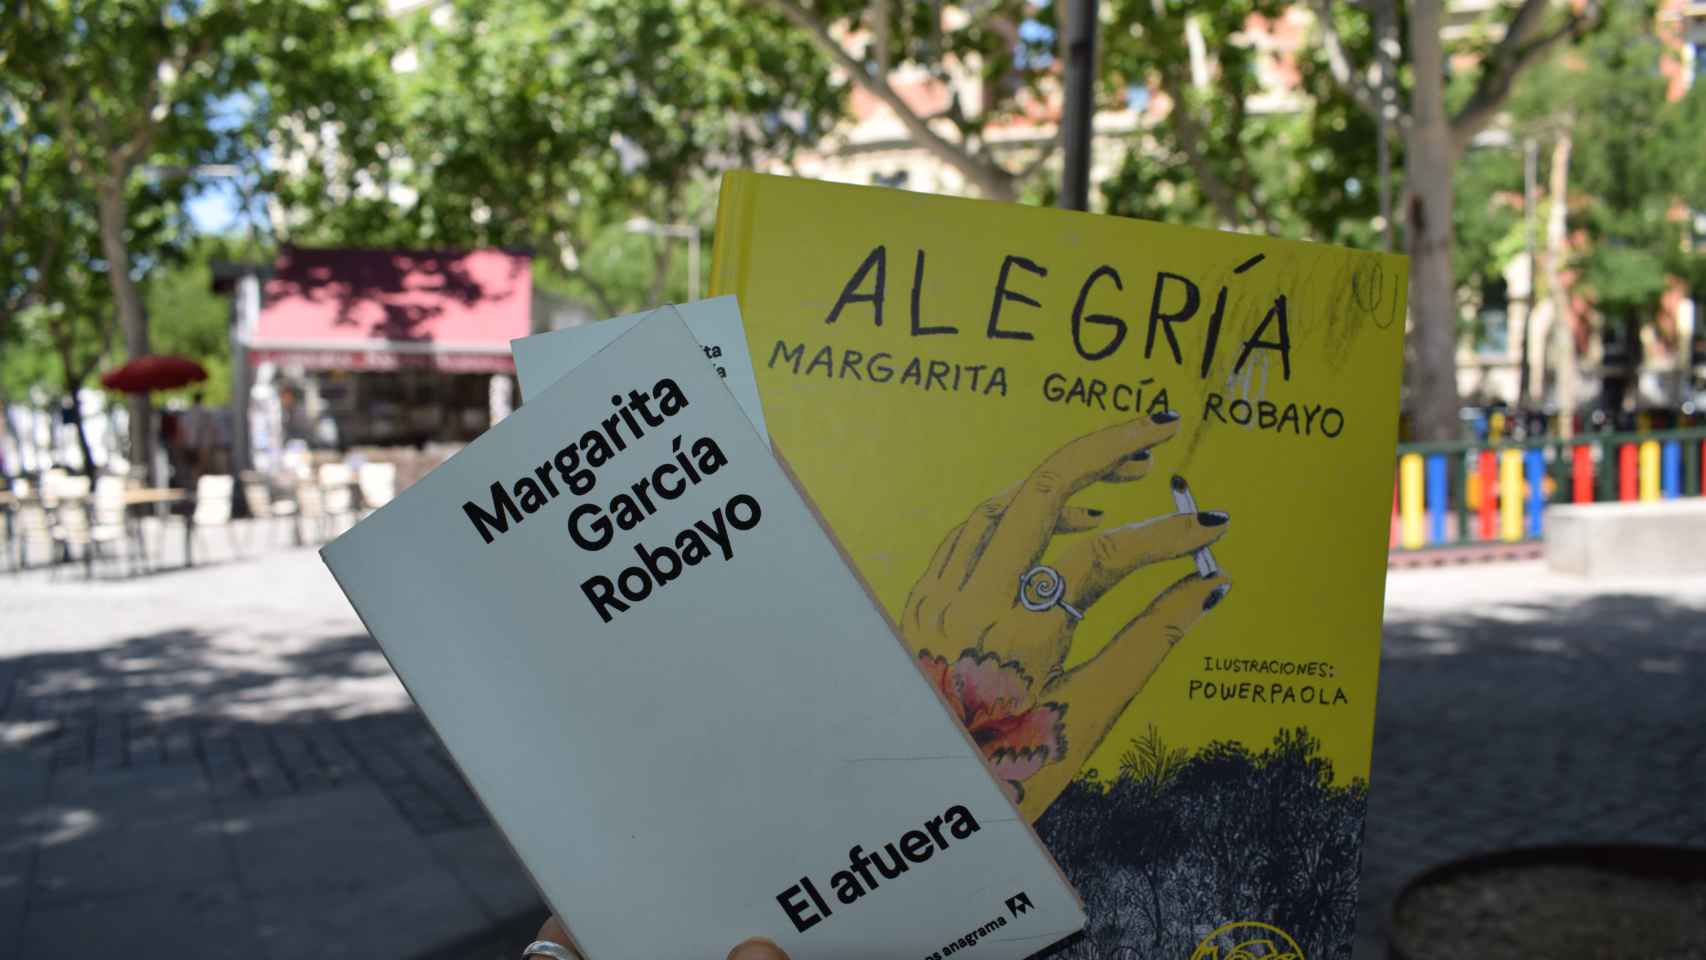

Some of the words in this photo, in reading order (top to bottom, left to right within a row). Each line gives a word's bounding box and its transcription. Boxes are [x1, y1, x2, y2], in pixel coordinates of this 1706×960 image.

[825, 245, 1291, 382] ALEGRÍA
[768, 338, 1008, 397] MARGARITA
[1043, 373, 1171, 416] GARCÍA
[1202, 392, 1346, 440] ROBAYO
[462, 377, 690, 545] Margarita
[567, 434, 729, 552] García
[580, 493, 763, 624] Robayo
[1187, 679, 1350, 706] POWERPAOLA
[1202, 656, 1336, 679] ILUSTRACIONES:
[775, 875, 833, 934] El
[829, 804, 982, 906] afuera
[941, 915, 1008, 957] anagrama
